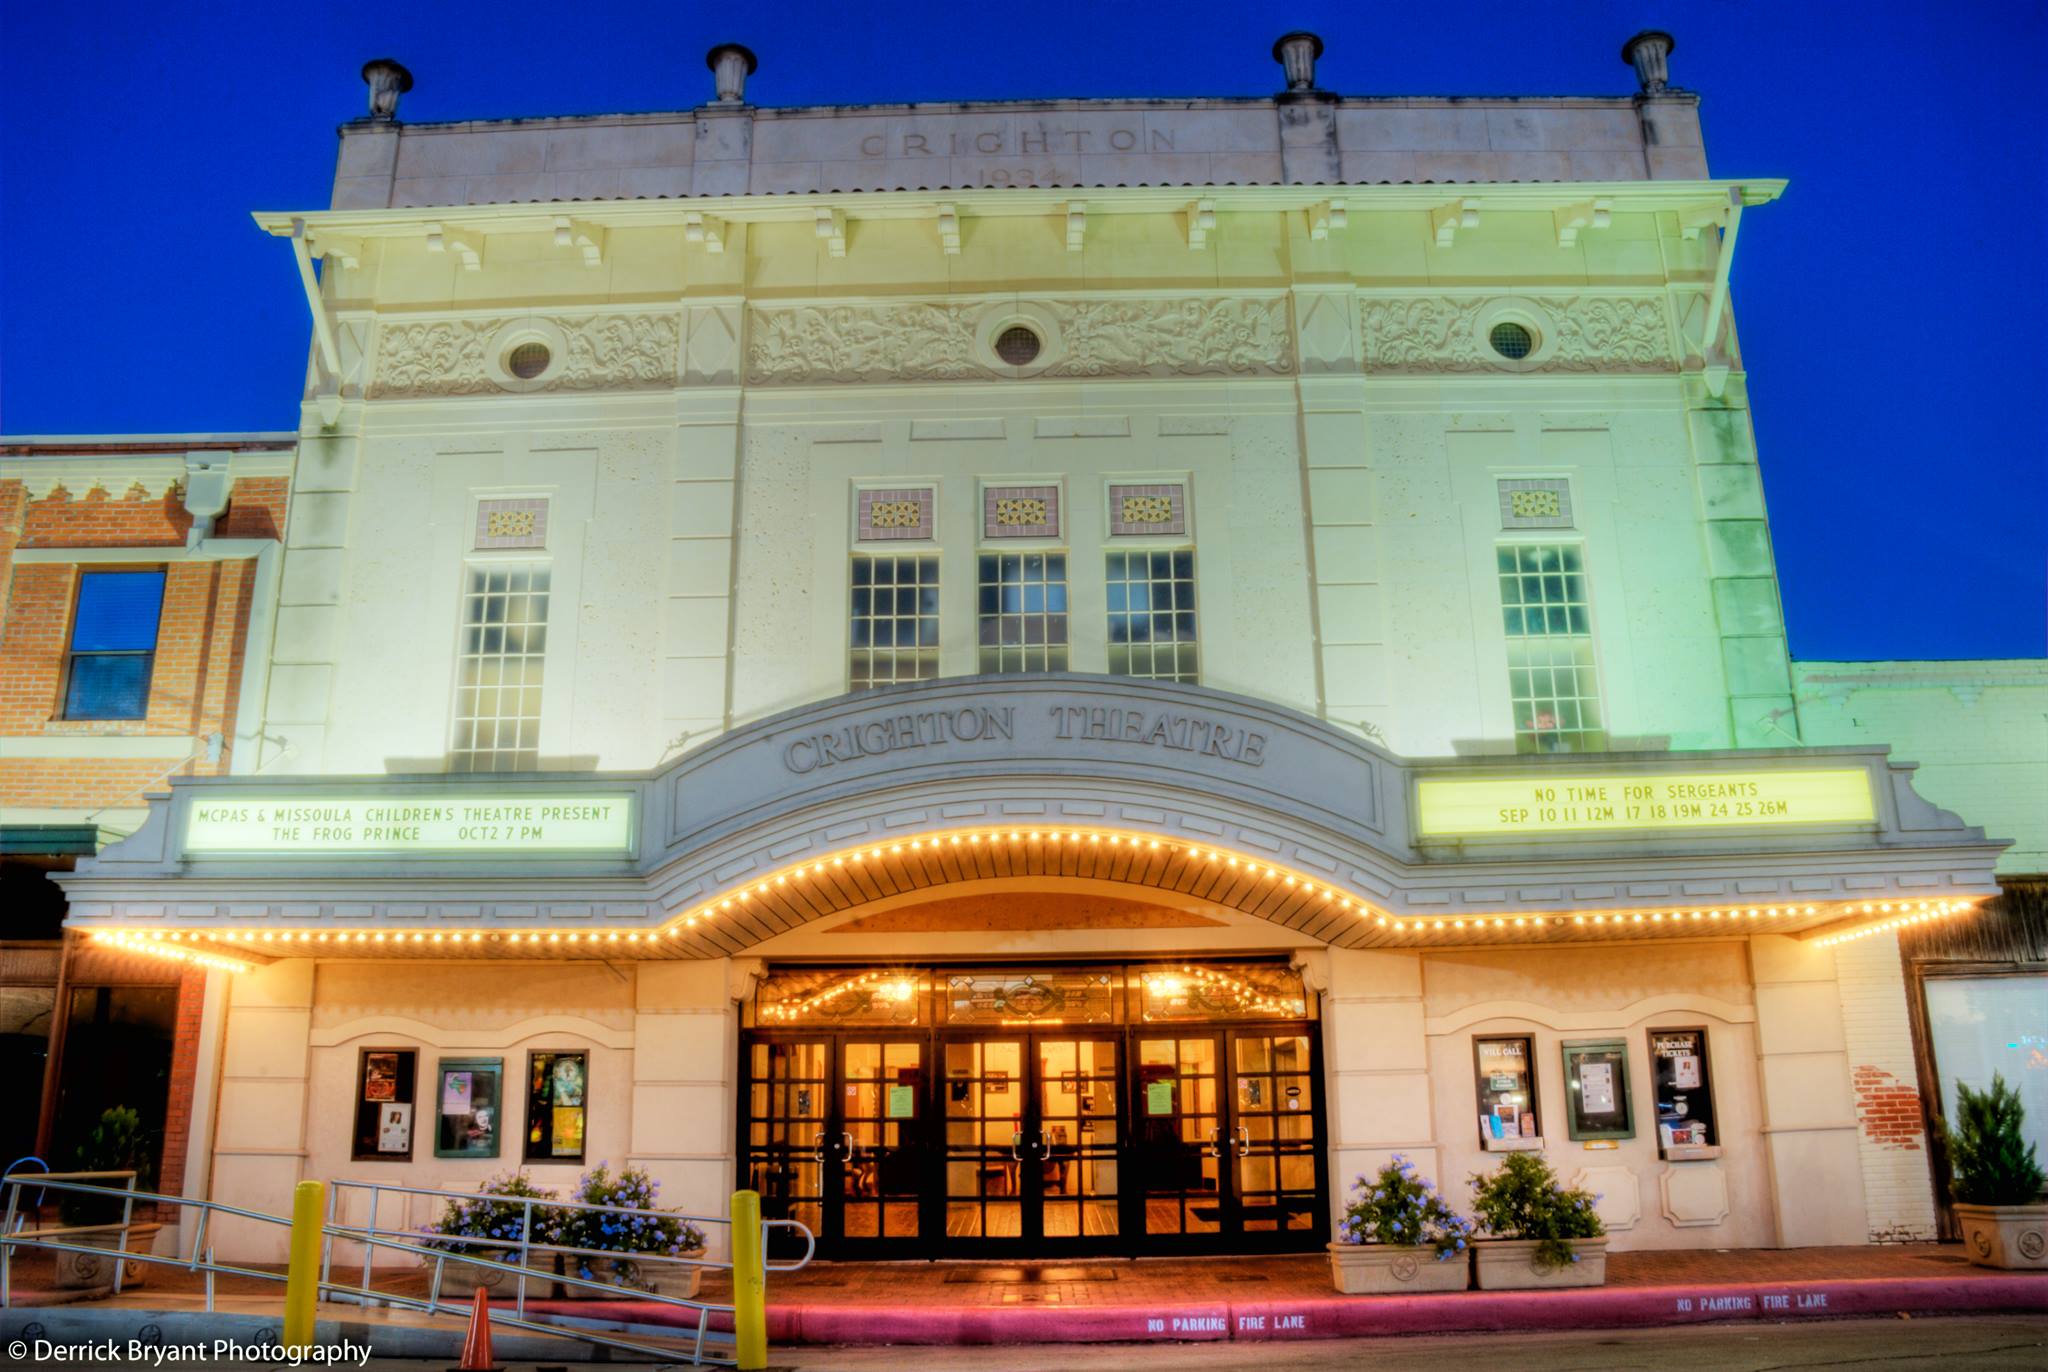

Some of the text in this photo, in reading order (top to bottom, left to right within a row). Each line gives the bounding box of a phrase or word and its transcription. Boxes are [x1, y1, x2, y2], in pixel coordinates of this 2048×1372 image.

[861, 129, 1176, 156] CRIGHTON
[782, 706, 1268, 775] CRIGHTON THEATRE
[1535, 783, 1758, 802] NO TIME FOR SERGEANTS
[198, 806, 611, 822] MCPAS & MISSOULA CHILDRENS THEATRE PRESENT
[1500, 809, 1528, 823] SEP
[1540, 808, 1557, 822] 10
[1564, 807, 1577, 821] 11
[1626, 806, 1640, 820] 17
[1650, 805, 1666, 818] 18
[1710, 803, 1728, 817] 24
[1736, 802, 1753, 816] 25
[272, 827, 300, 841] THE
[313, 827, 352, 841] FROG
[363, 827, 421, 841] PRINCE
[520, 826, 543, 839] PM
[1677, 1294, 1828, 1312] NO PARKING FIRE LANE
[1148, 1315, 1305, 1332] NO PARKING FIRE LANE
